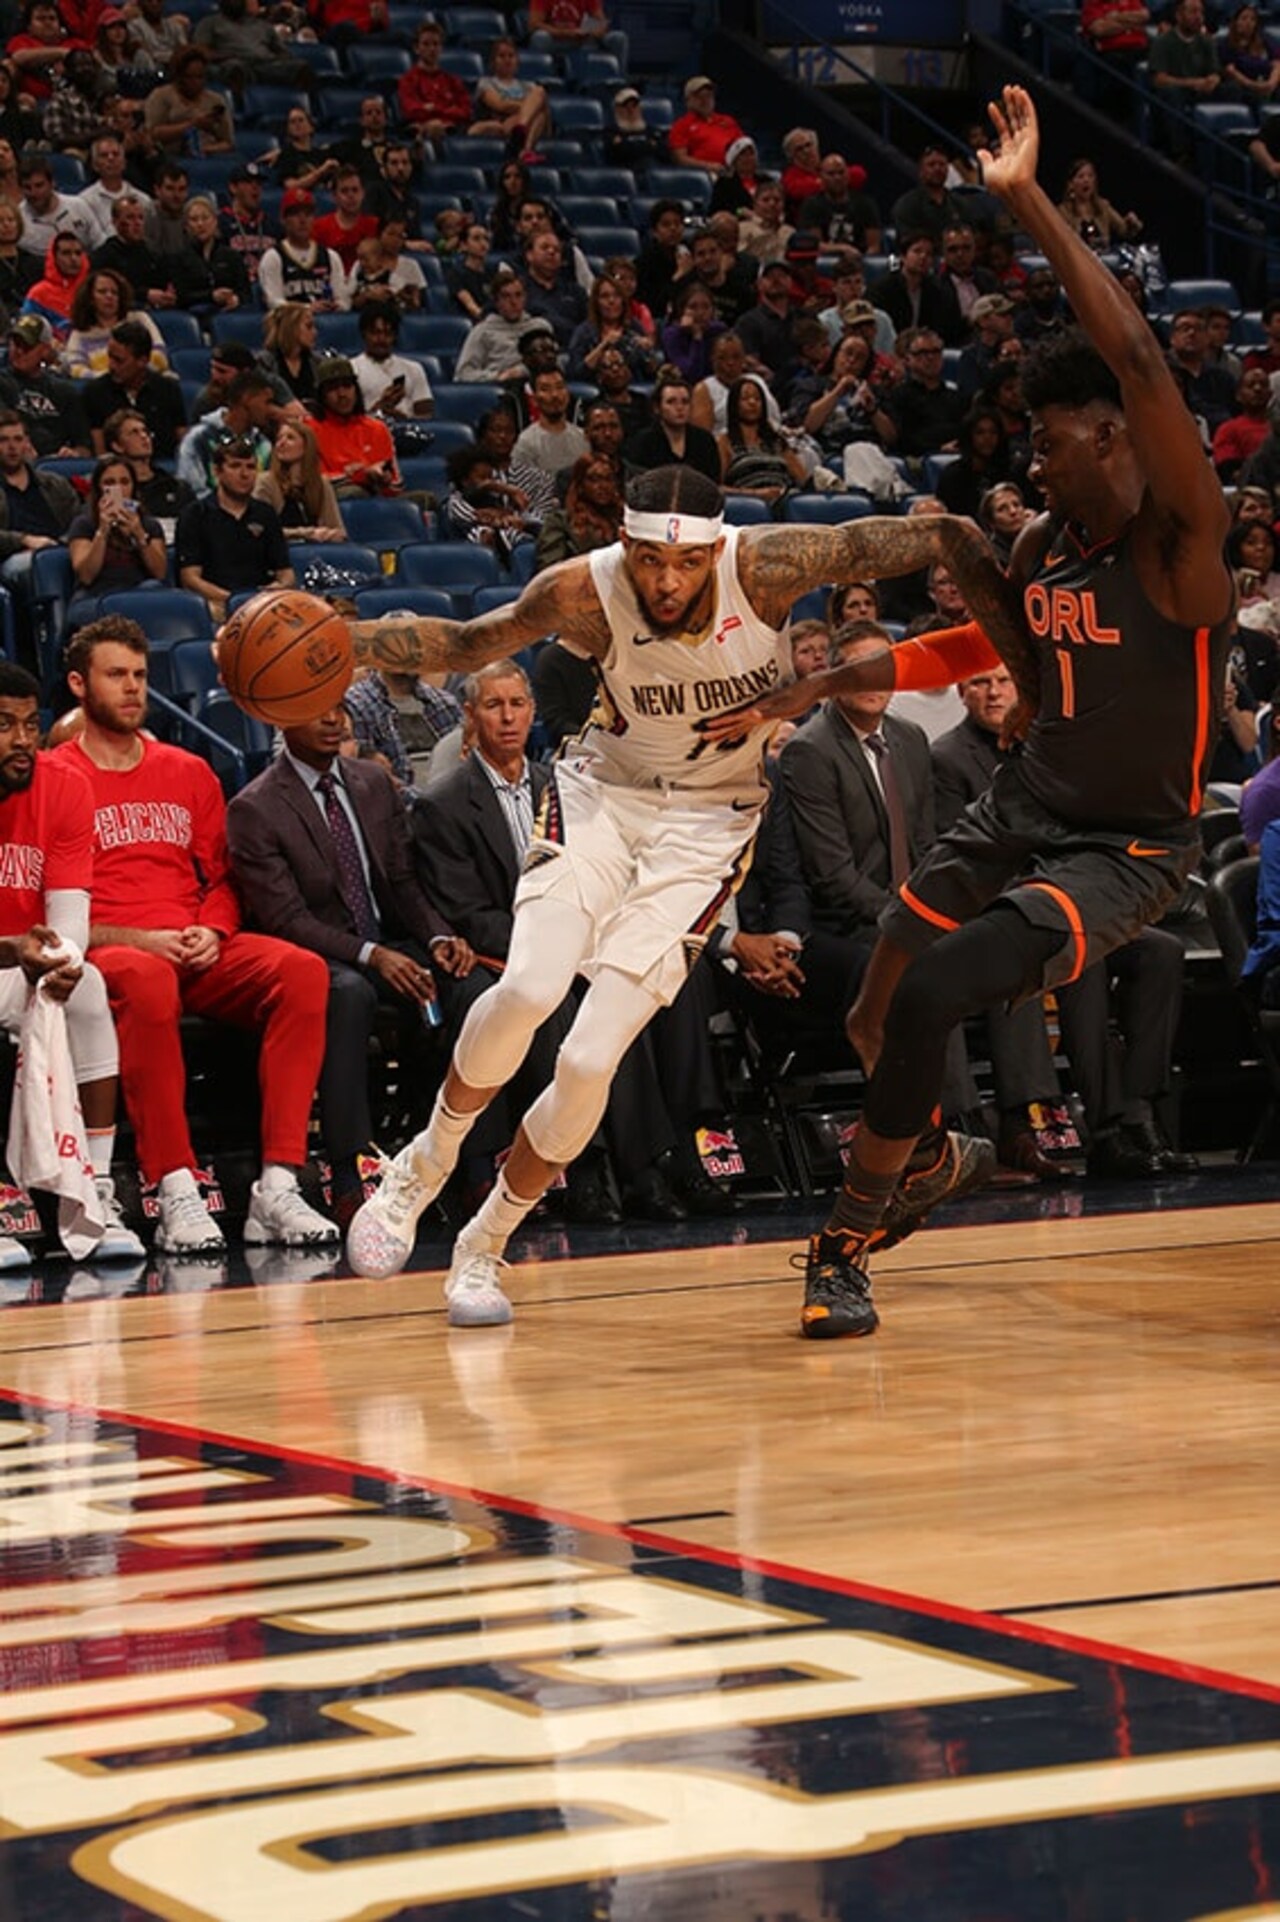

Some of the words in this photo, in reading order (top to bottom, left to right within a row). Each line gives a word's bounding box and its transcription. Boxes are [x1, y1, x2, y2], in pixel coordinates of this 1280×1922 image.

[838, 5, 883, 16] VODKA
[785, 43, 837, 85] 112
[902, 48, 944, 87] 113
[1024, 583, 1121, 645] ORL
[631, 684, 685, 715] NEW
[1056, 648, 1075, 719] 1
[94, 801, 193, 851] ELICANS
